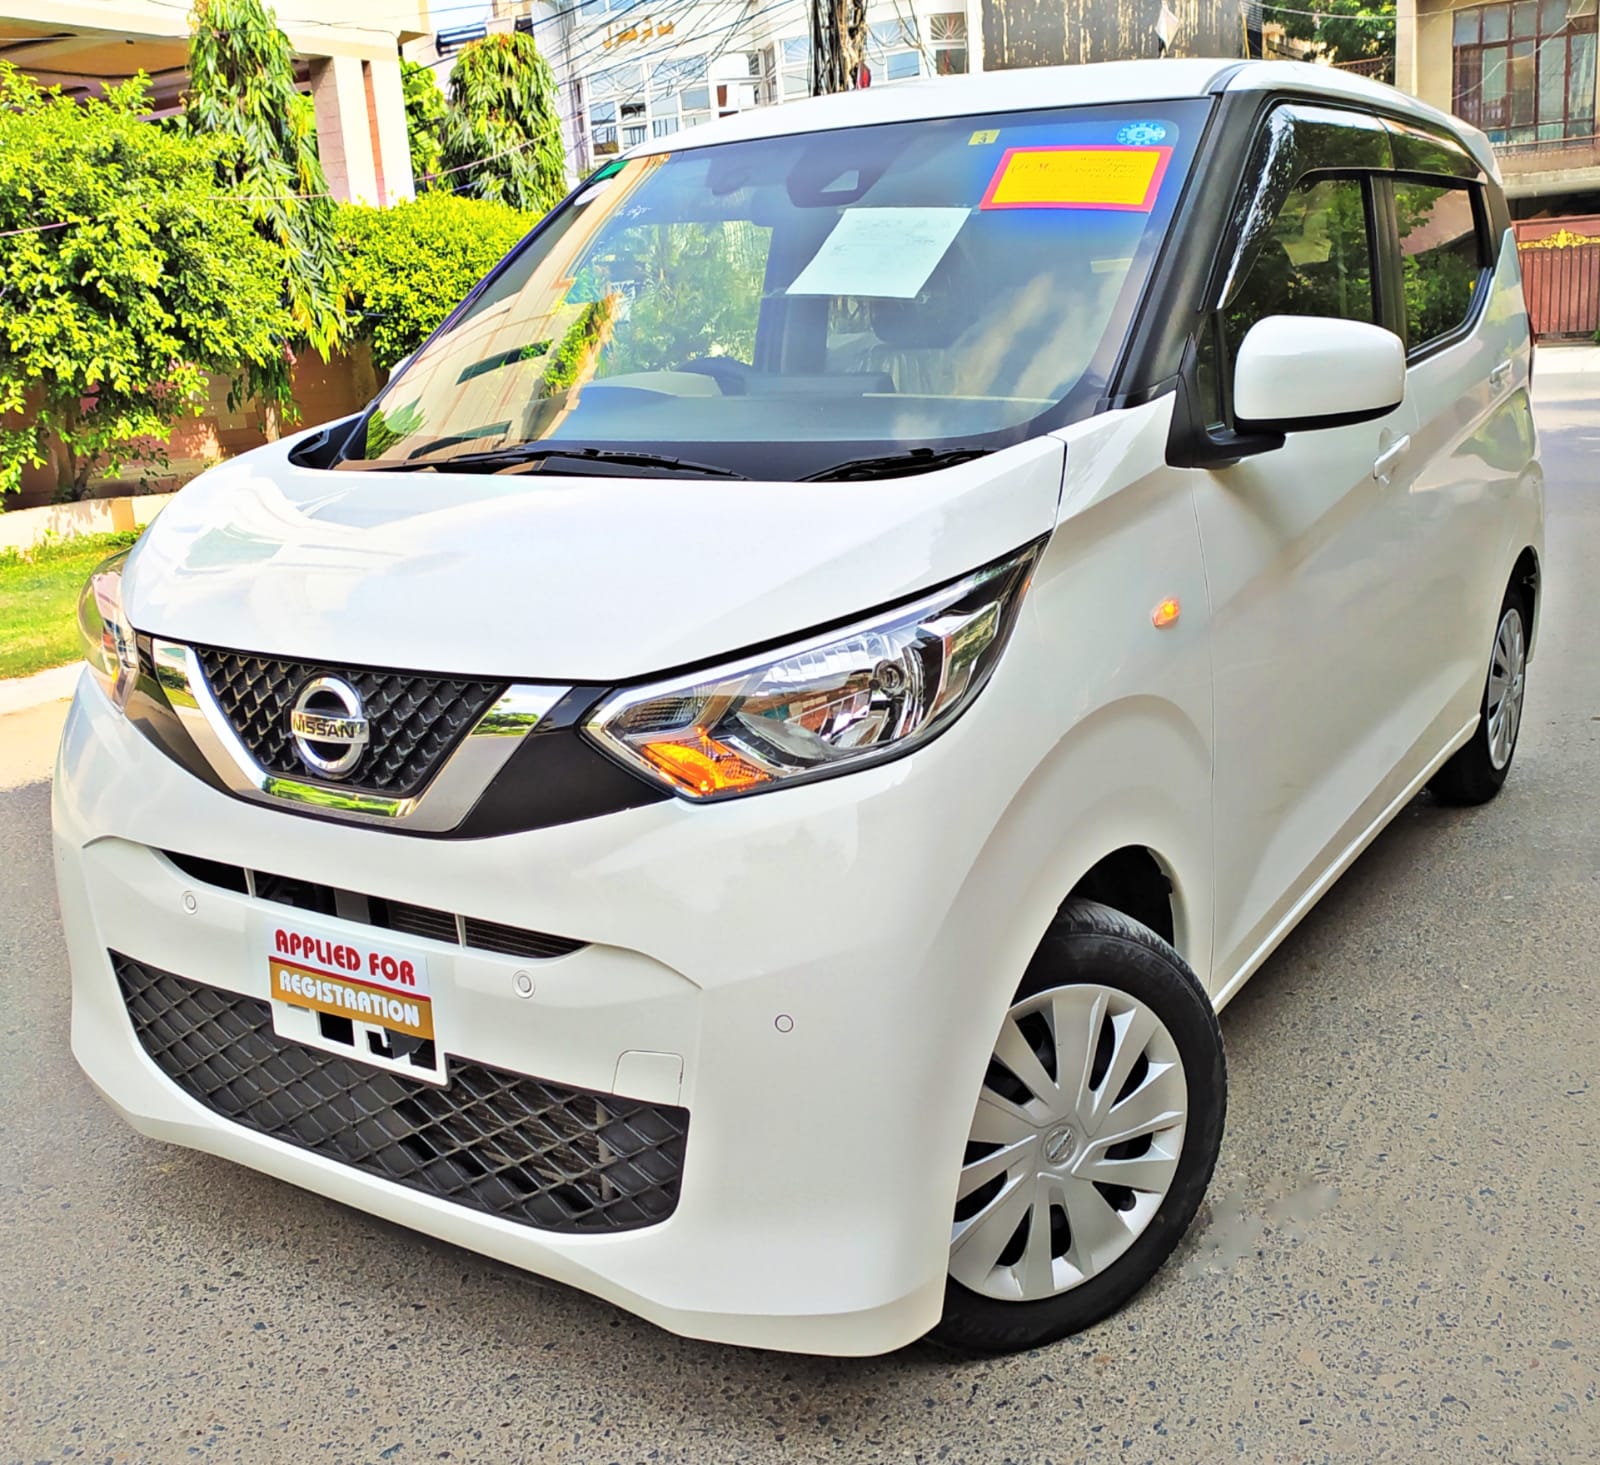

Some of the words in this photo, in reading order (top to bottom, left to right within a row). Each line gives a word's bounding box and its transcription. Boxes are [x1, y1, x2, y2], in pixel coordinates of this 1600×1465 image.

[292, 718, 355, 739] NISSAN
[275, 928, 362, 972] APPLIED
[369, 952, 416, 986] FOR
[279, 970, 420, 1028] REGISTRATION
